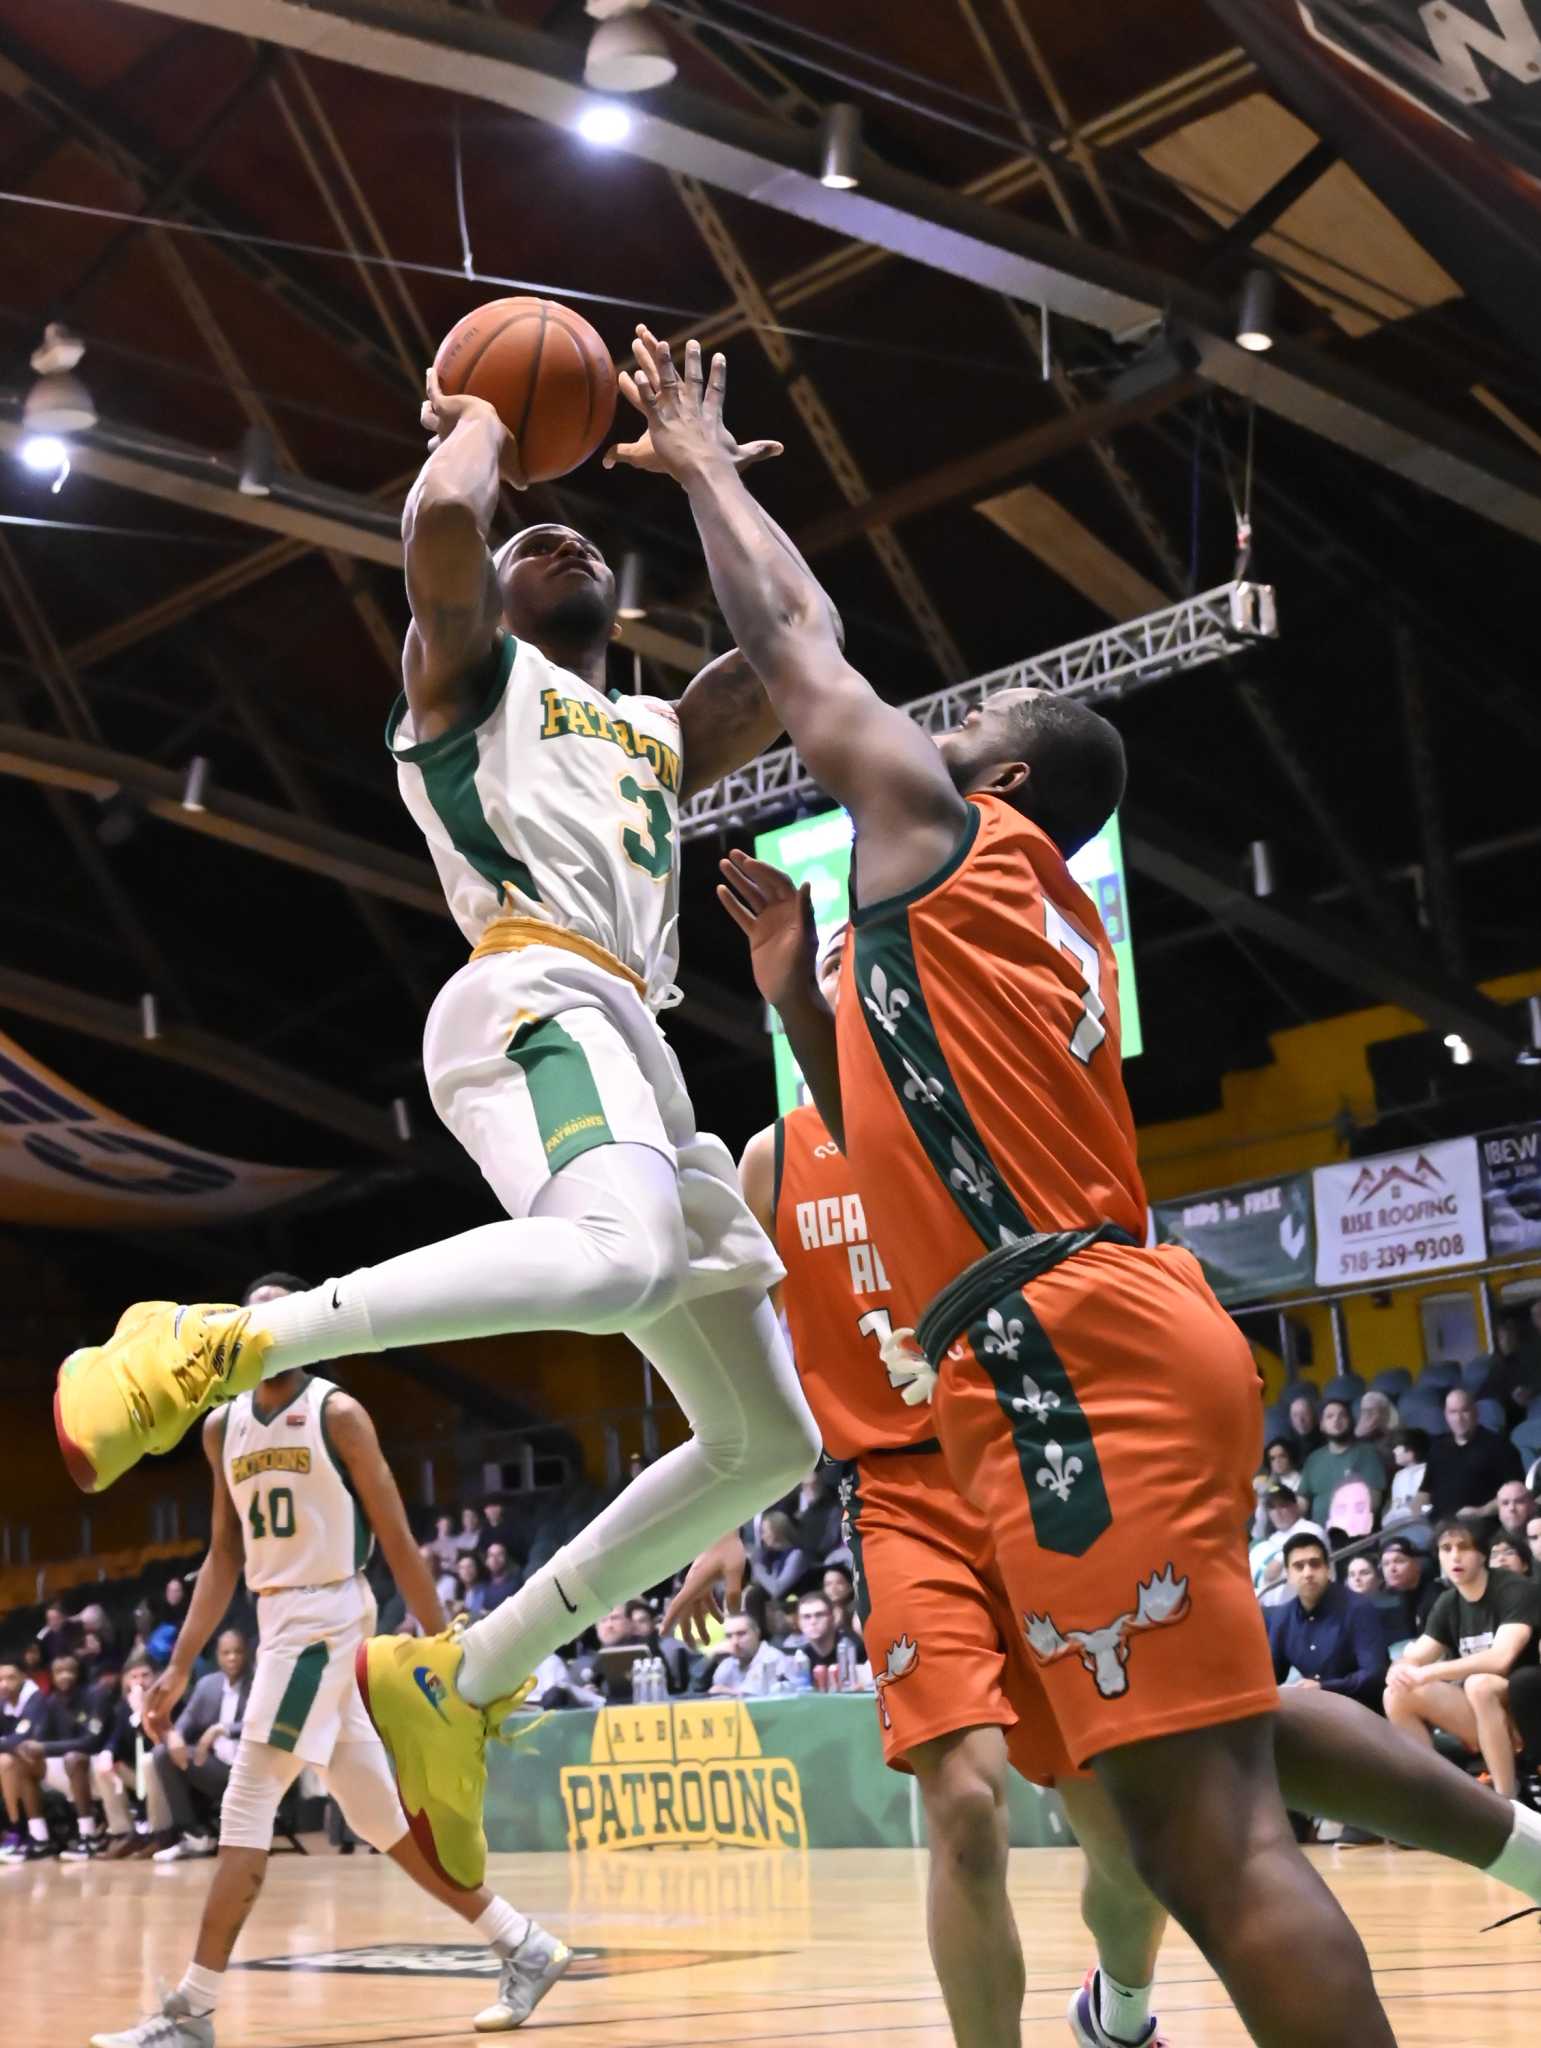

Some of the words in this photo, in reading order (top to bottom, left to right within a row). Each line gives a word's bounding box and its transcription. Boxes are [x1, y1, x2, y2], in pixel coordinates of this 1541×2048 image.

[617, 769, 674, 881] 3
[1484, 1133, 1538, 1165] IBEW
[1341, 1211, 1374, 1235] RISE
[1377, 1194, 1458, 1227] ROOFING
[1340, 1234, 1464, 1275] 518-339-9308
[249, 1487, 296, 1540] 40
[611, 1716, 737, 1744] ALBANY
[567, 1767, 801, 1850] PATROONS
